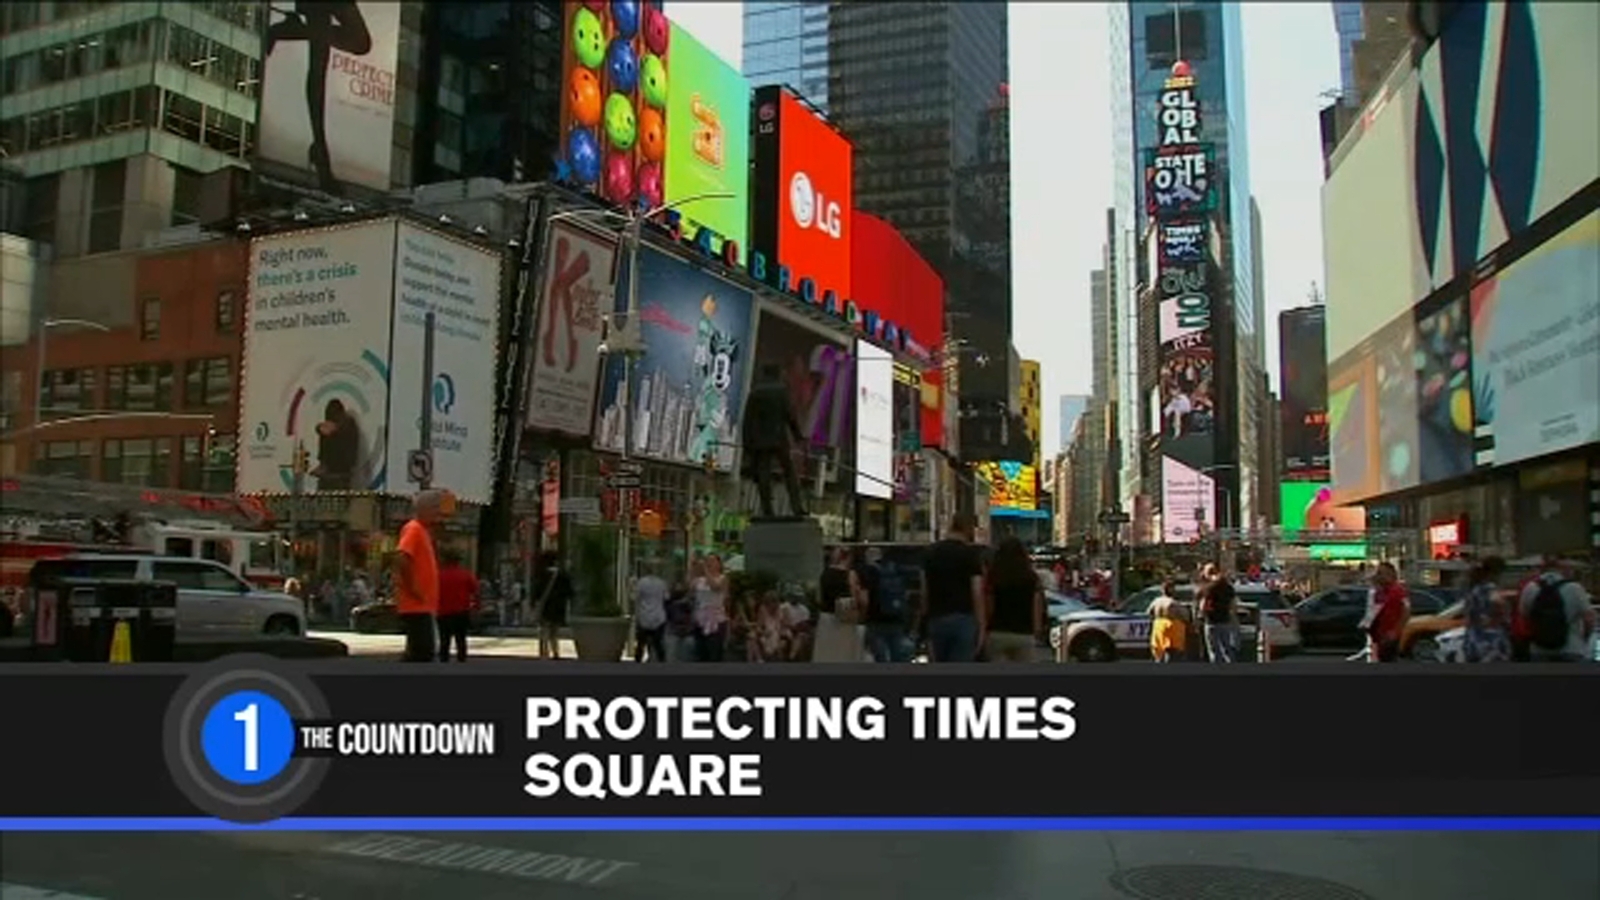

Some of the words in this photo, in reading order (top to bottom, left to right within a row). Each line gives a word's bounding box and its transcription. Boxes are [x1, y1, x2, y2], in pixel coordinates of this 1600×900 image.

[332, 53, 394, 88] PERFECT
[759, 122, 775, 134] LG
[816, 192, 842, 239] LG
[260, 247, 294, 268] Right
[297, 246, 329, 261] now,
[257, 268, 302, 287] there's
[305, 269, 316, 282] a
[318, 262, 358, 281] crisis
[255, 298, 268, 311] in
[270, 287, 336, 309] children's
[752, 250, 912, 351] BROADWAY
[255, 313, 300, 332] mental
[302, 309, 351, 328] health.
